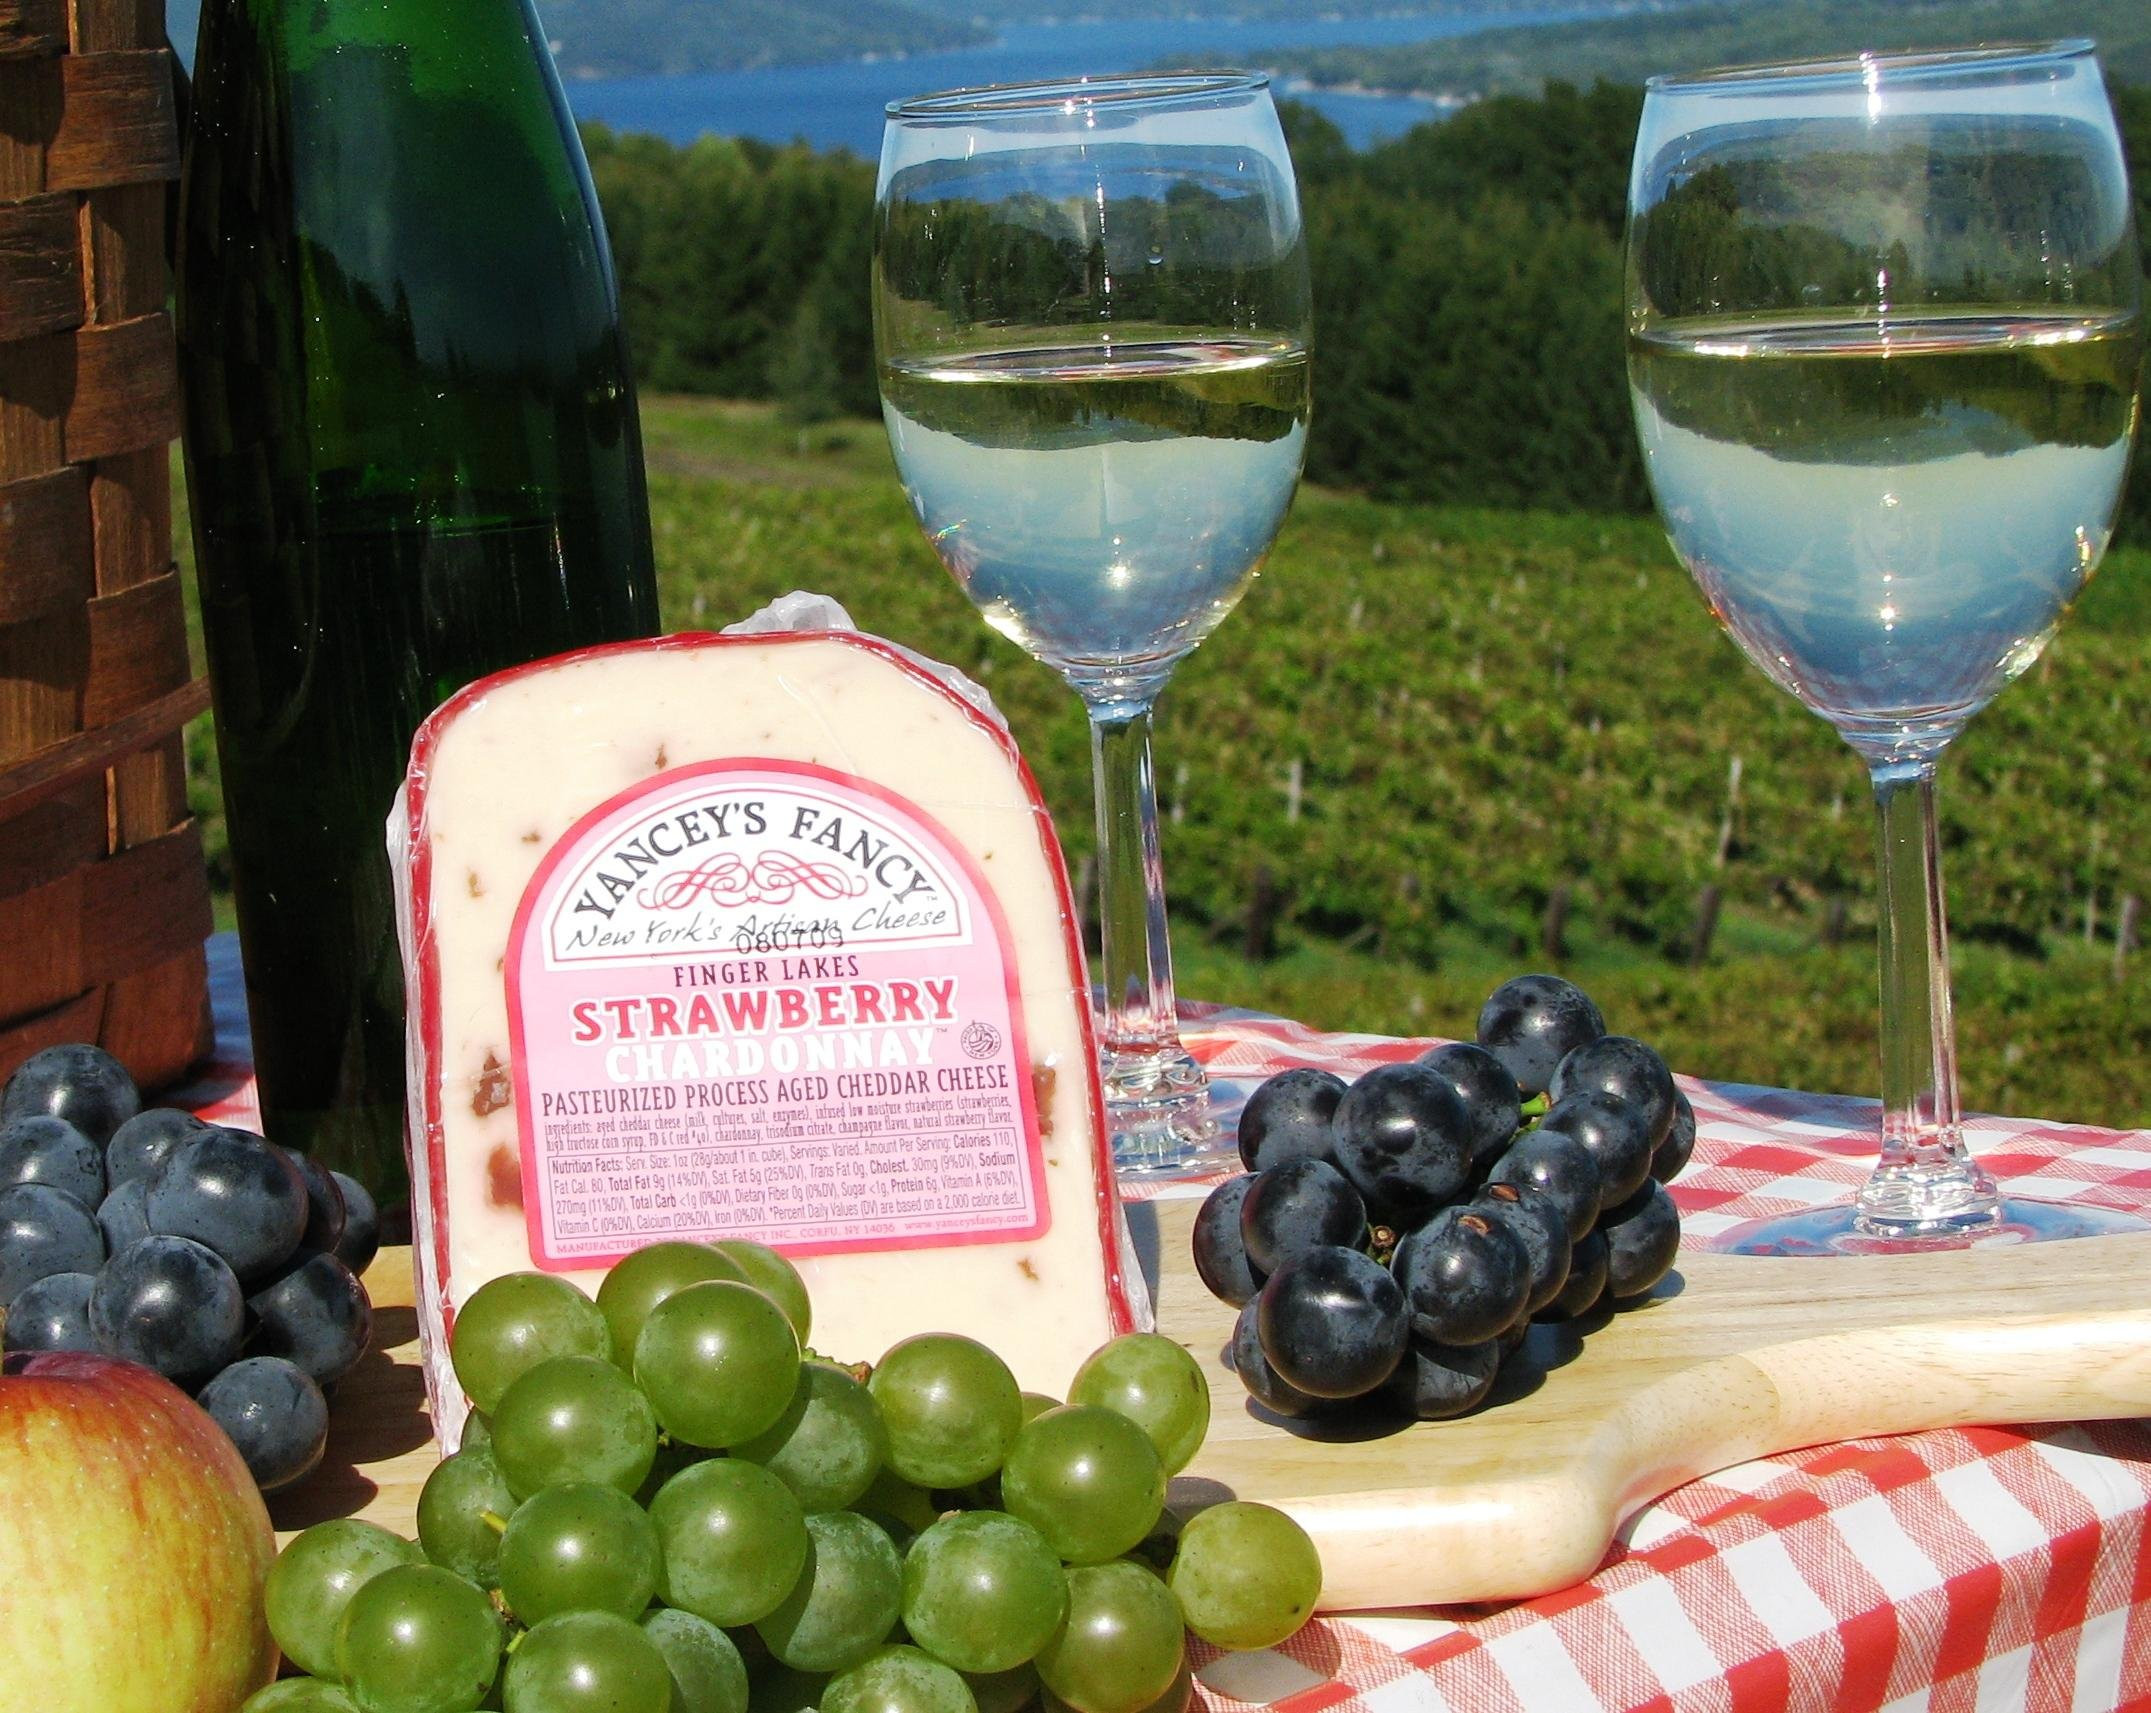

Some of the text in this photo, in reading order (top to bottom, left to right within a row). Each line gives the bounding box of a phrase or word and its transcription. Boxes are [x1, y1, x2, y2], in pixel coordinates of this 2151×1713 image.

[574, 802, 767, 920] YANCEY'S
[788, 806, 936, 904] FANCY
[565, 900, 947, 951] New York's Artisan Cheese
[674, 955, 860, 987] FINGER LAKES
[573, 979, 954, 1041] STRAWBERRY
[605, 1027, 934, 1083] CHARDONNAY
[541, 1065, 1009, 1117] PASTEURIZED PROCESS AGED CHEDDAR CHEESE
[546, 1138, 563, 1156] high
[566, 1135, 598, 1151] fructose
[601, 1136, 619, 1148] corn
[912, 1114, 941, 1129] natural
[944, 1110, 985, 1130] strawberry
[596, 1119, 615, 1135] aged
[618, 1114, 650, 1131] cheddar
[654, 1113, 680, 1129] cheese
[815, 1102, 845, 1119] infused
[848, 1101, 862, 1117] low
[866, 1100, 901, 1115] moisture
[904, 1096, 953, 1113] strawberries
[552, 1158, 592, 1174] Nutrition
[864, 1138, 897, 1154] Amount
[899, 1137, 913, 1152] Per
[952, 1132, 991, 1148] Calories
[554, 1179, 568, 1194] Fat
[608, 1175, 632, 1191] Total
[634, 1174, 650, 1189] Fat
[732, 1168, 747, 1183] Fat
[809, 1162, 833, 1178] Trans
[836, 1161, 850, 1176] Fat
[978, 1151, 1015, 1167] Sodium
[557, 1218, 589, 1234] Vitamin
[636, 1212, 671, 1228] Calcium
[714, 1209, 731, 1224] Iron
[807, 1202, 829, 1220] Daily
[829, 1201, 858, 1216] Values
[879, 1202, 893, 1213] are
[896, 1196, 921, 1212] based
[923, 1199, 934, 1209] on
[971, 1191, 999, 1206] calorie
[630, 1194, 652, 1209] Total
[655, 1192, 676, 1208] Carb
[735, 1187, 766, 1205] Dietary
[768, 1185, 789, 1200] Fiber
[840, 1180, 866, 1198] Sugar
[890, 1176, 923, 1192] Protein
[941, 1173, 973, 1189] Vitamin
